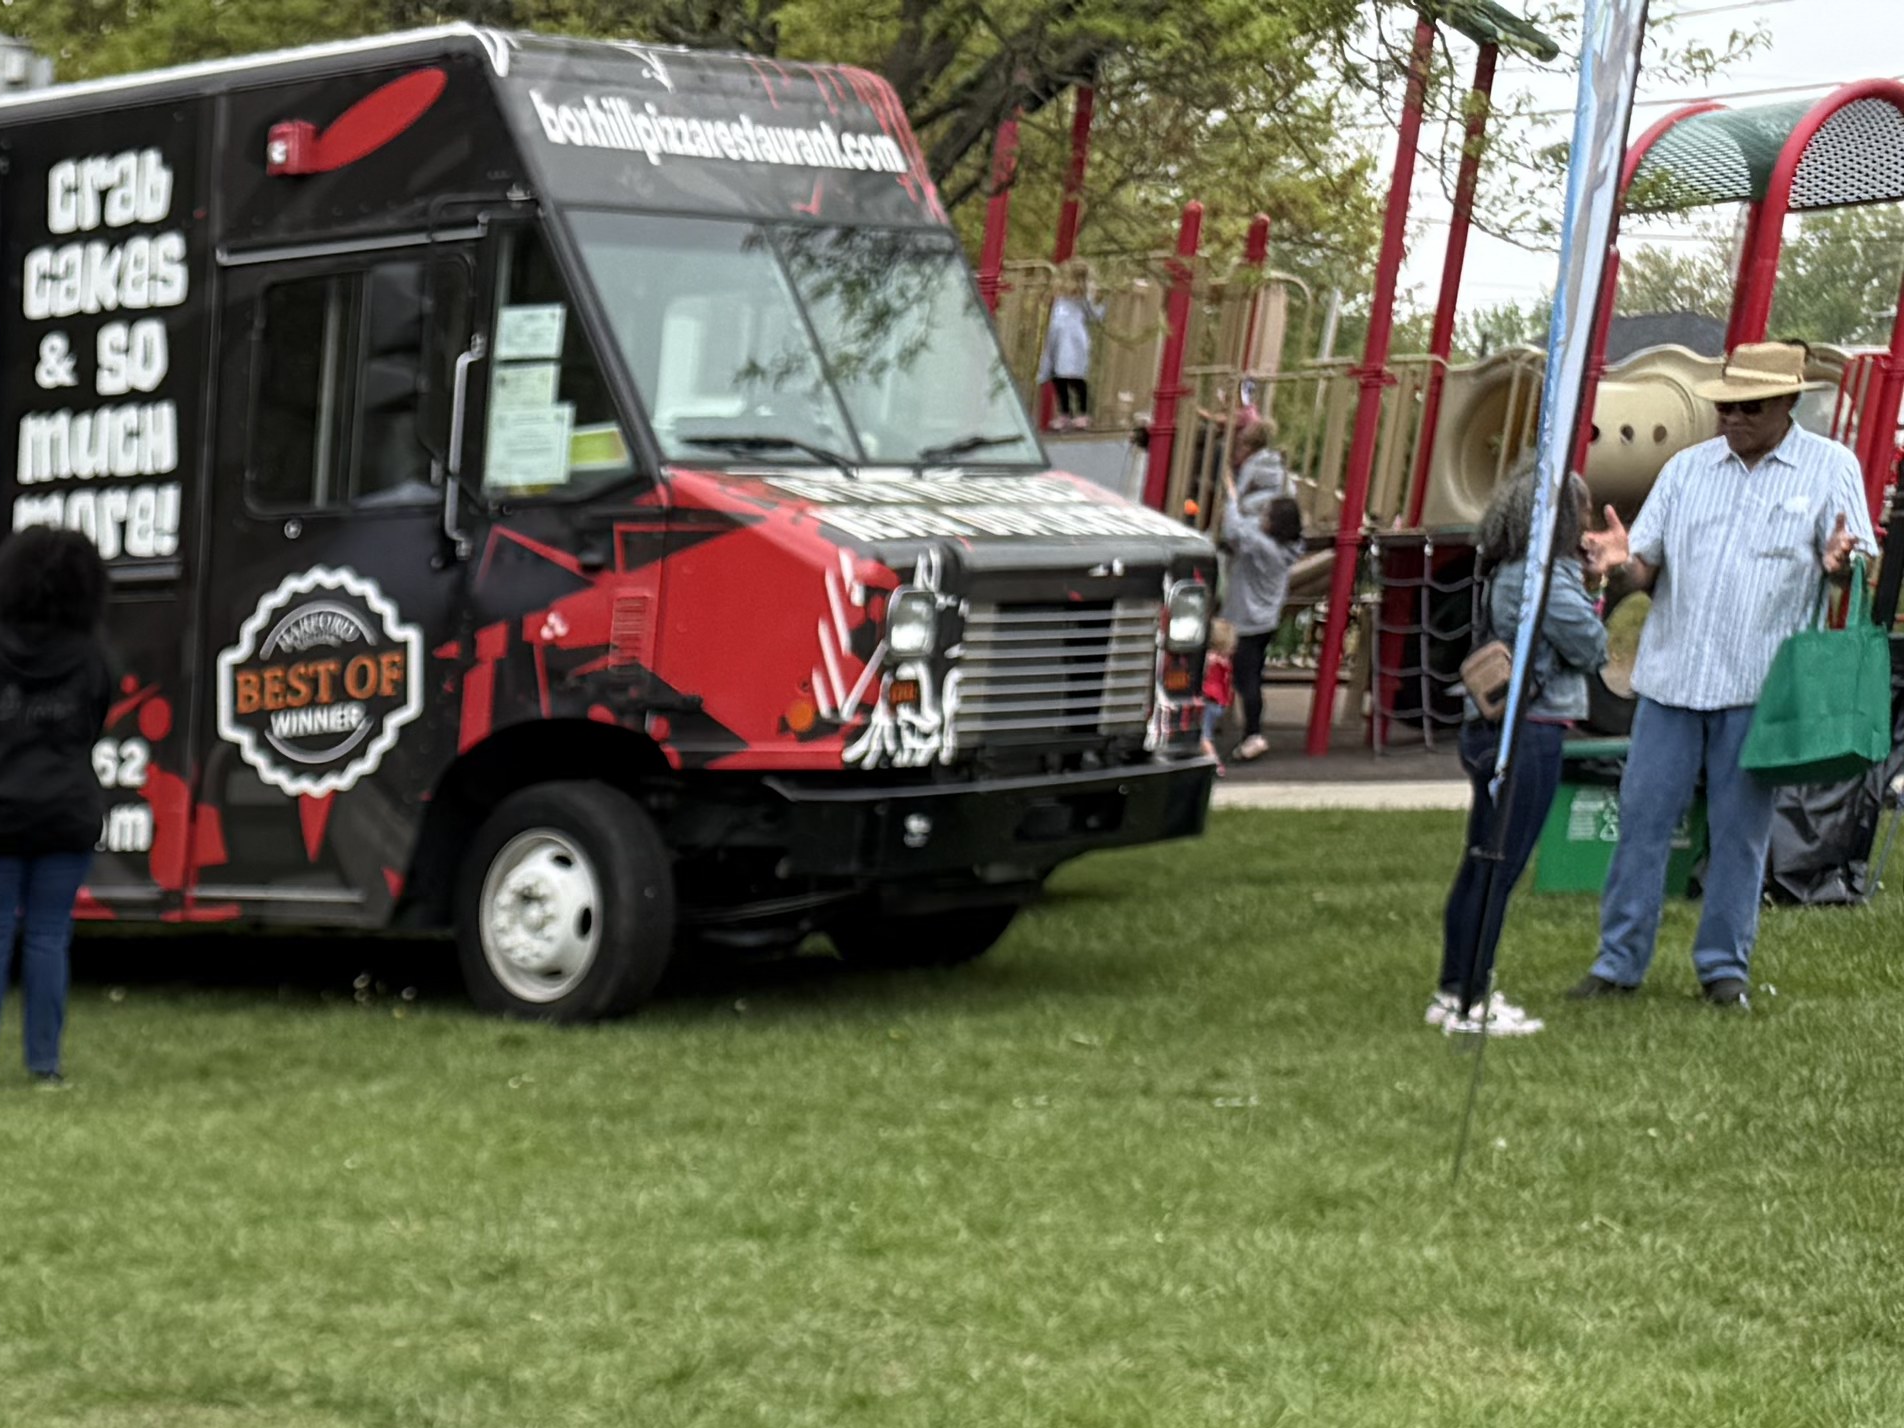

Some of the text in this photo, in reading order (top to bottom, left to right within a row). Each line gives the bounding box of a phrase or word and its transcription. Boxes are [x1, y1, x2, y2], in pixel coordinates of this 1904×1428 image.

[34, 330, 80, 390] &
[235, 650, 405, 715] BEST OF
[270, 702, 367, 739] WINNER
